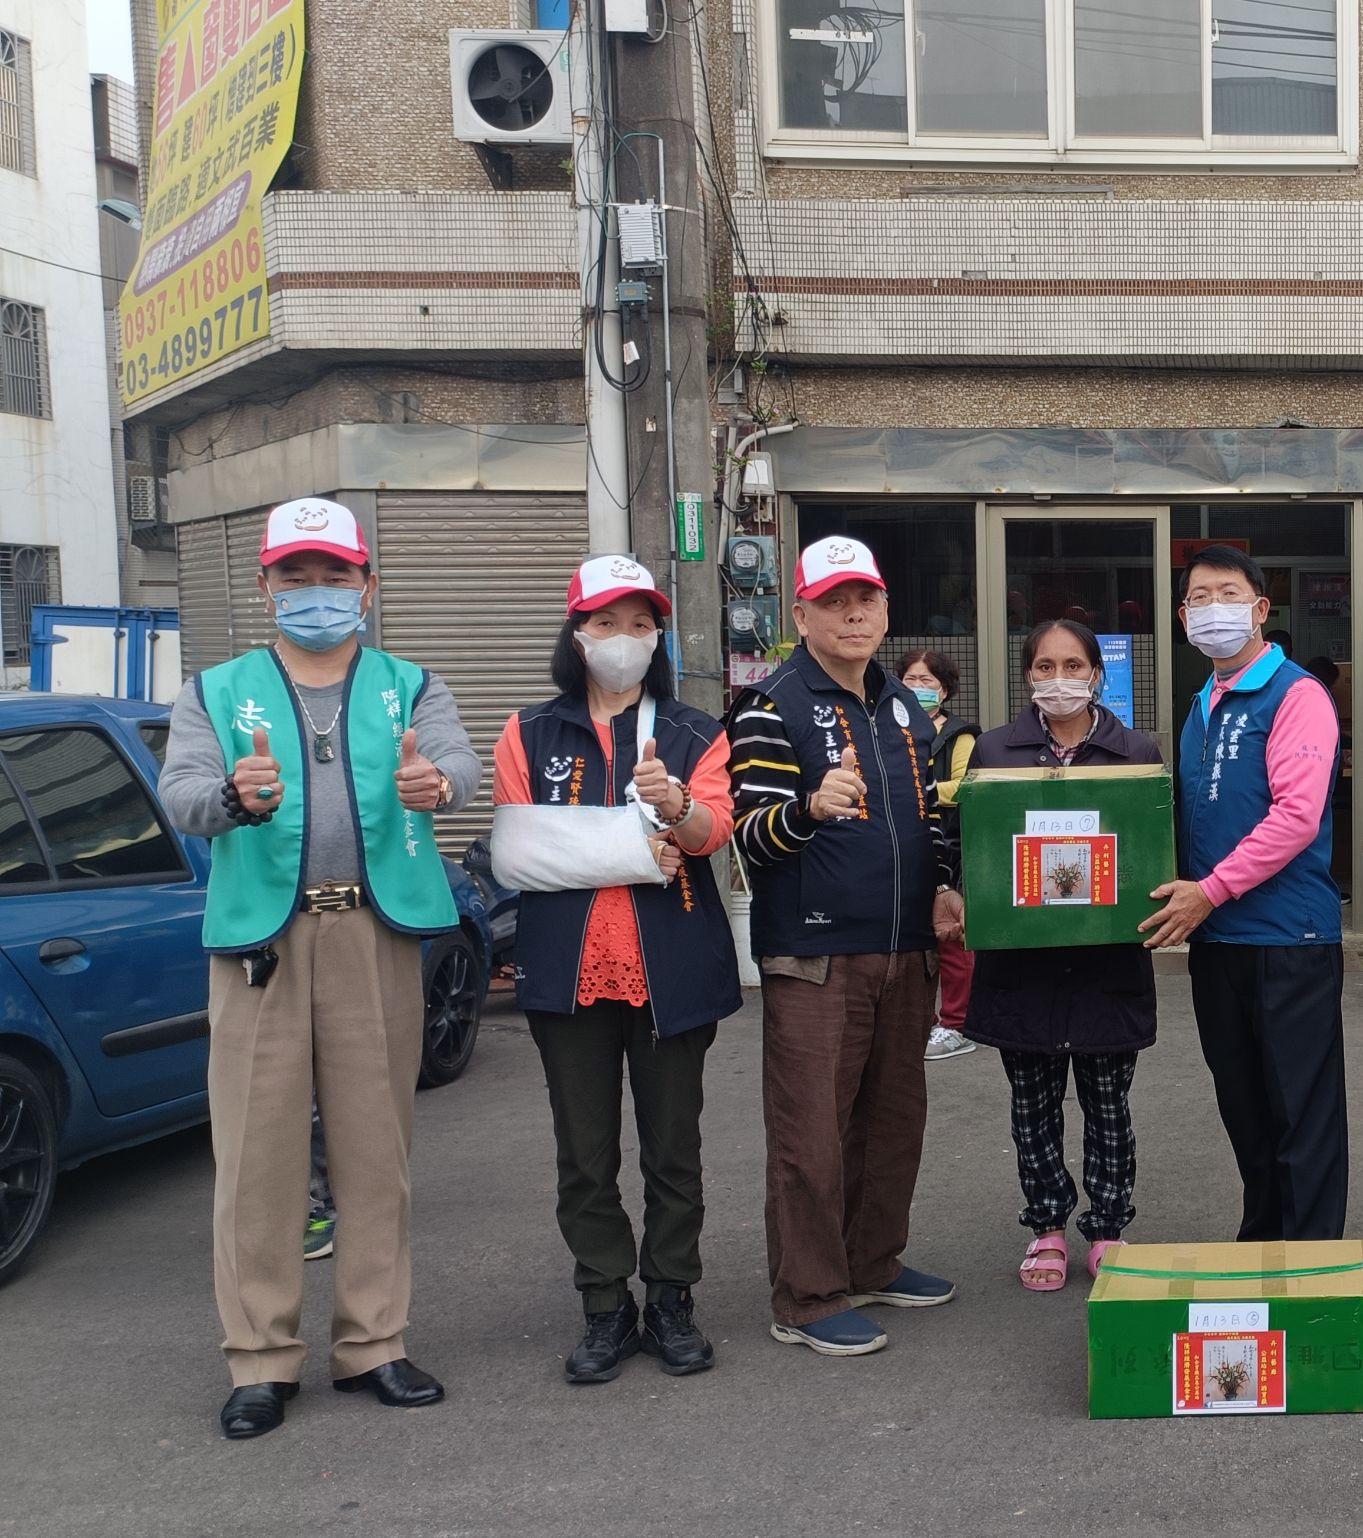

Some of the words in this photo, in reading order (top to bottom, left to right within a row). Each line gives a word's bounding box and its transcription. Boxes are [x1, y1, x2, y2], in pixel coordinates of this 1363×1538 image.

[125, 226, 261, 350] 0937-118806
[126, 285, 263, 396] 03-4899777
[686, 503, 697, 551] 0311032
[231, 699, 272, 736] 志
[825, 731, 841, 764] 主任
[1195, 1314, 1241, 1327] 1月13日
